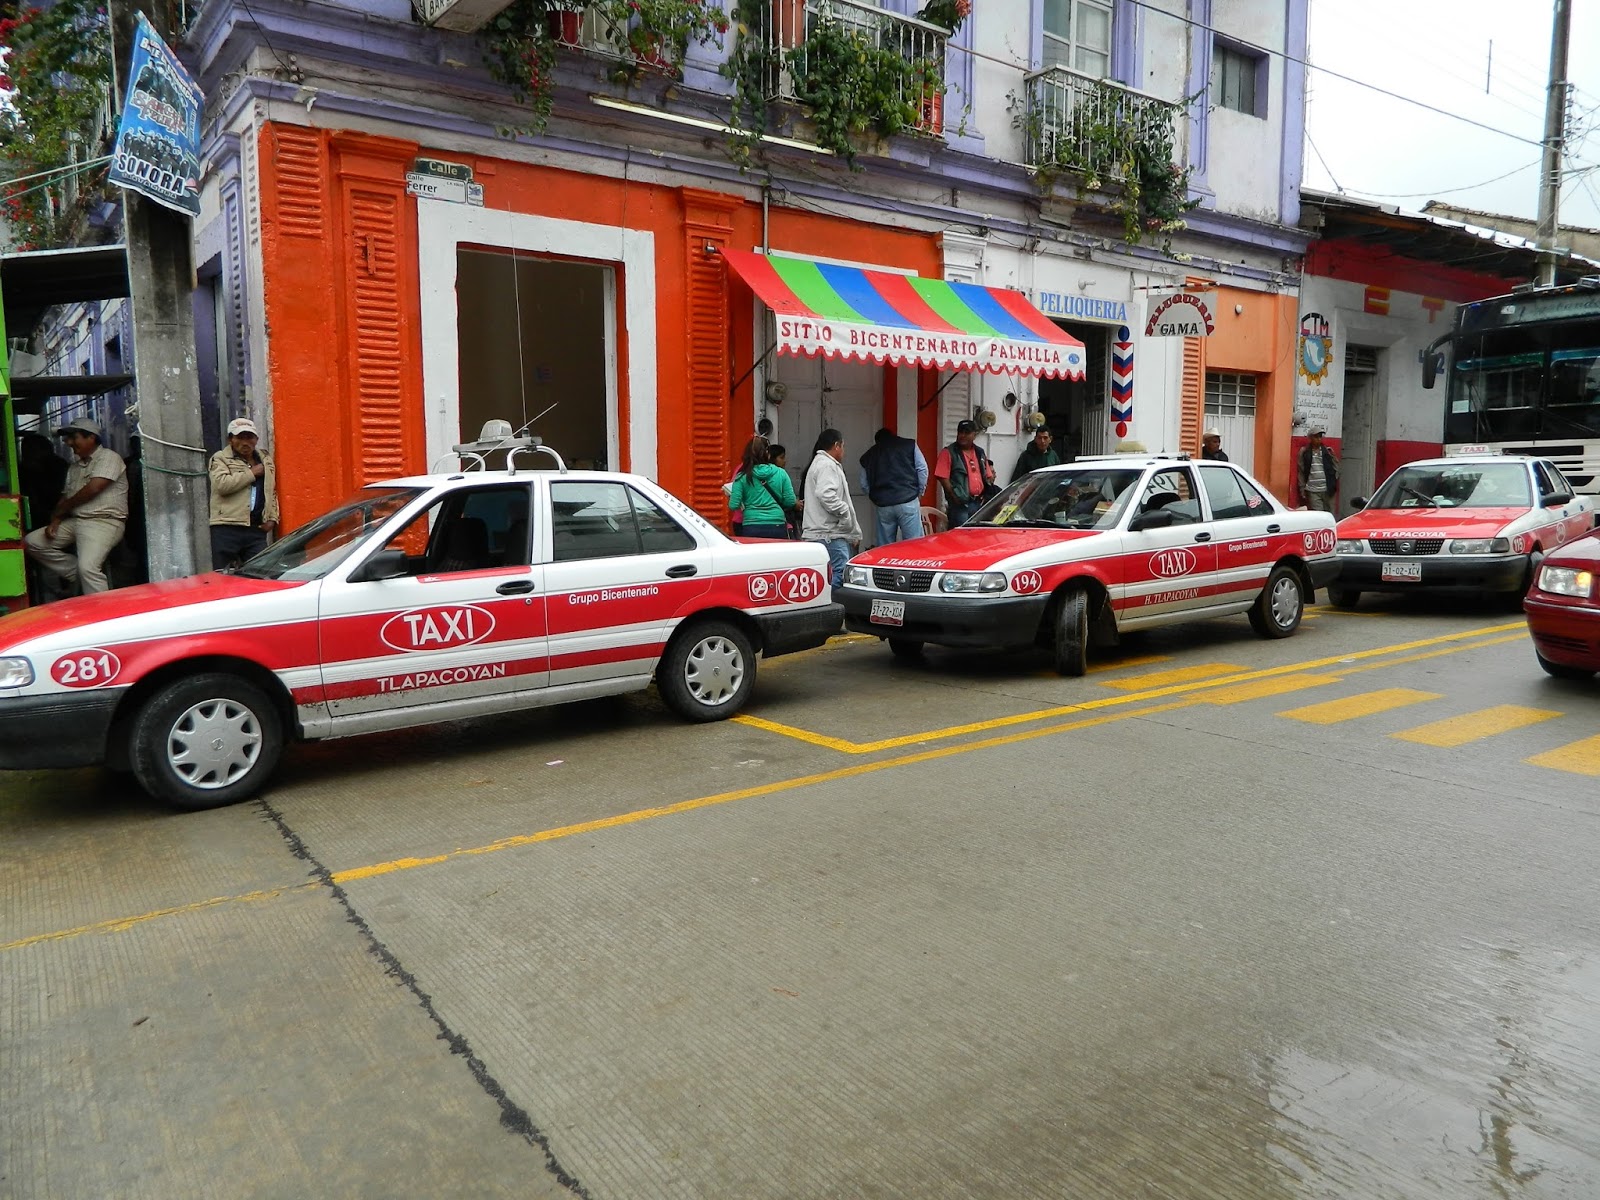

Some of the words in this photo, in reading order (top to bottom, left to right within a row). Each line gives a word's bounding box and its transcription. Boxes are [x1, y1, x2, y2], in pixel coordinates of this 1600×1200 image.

[118, 153, 185, 196] SONORA
[429, 161, 458, 176] Calle
[407, 181, 438, 193] Ferrer
[1040, 291, 1127, 321] PELUQUERIA
[1145, 293, 1215, 337] PELUQUERIA
[781, 321, 832, 342] SITIO
[850, 329, 978, 357] BICENTENARIO
[989, 343, 1061, 364] PALMILLA
[1228, 543, 1243, 553] Grupo
[1242, 539, 1268, 550] Bicentenario
[1319, 531, 1334, 550] 194
[887, 557, 946, 567] TLAPACOYAN
[1158, 551, 1187, 575] TAXI
[568, 592, 600, 606] Grupo
[601, 584, 659, 602] Bicentenario
[787, 572, 818, 599] 281
[1013, 574, 1037, 592] 194
[1153, 588, 1199, 604] TLAPACOYAN
[403, 608, 474, 646] TAXI
[58, 654, 111, 684] 281
[377, 663, 506, 692] TLAPACOYAN
